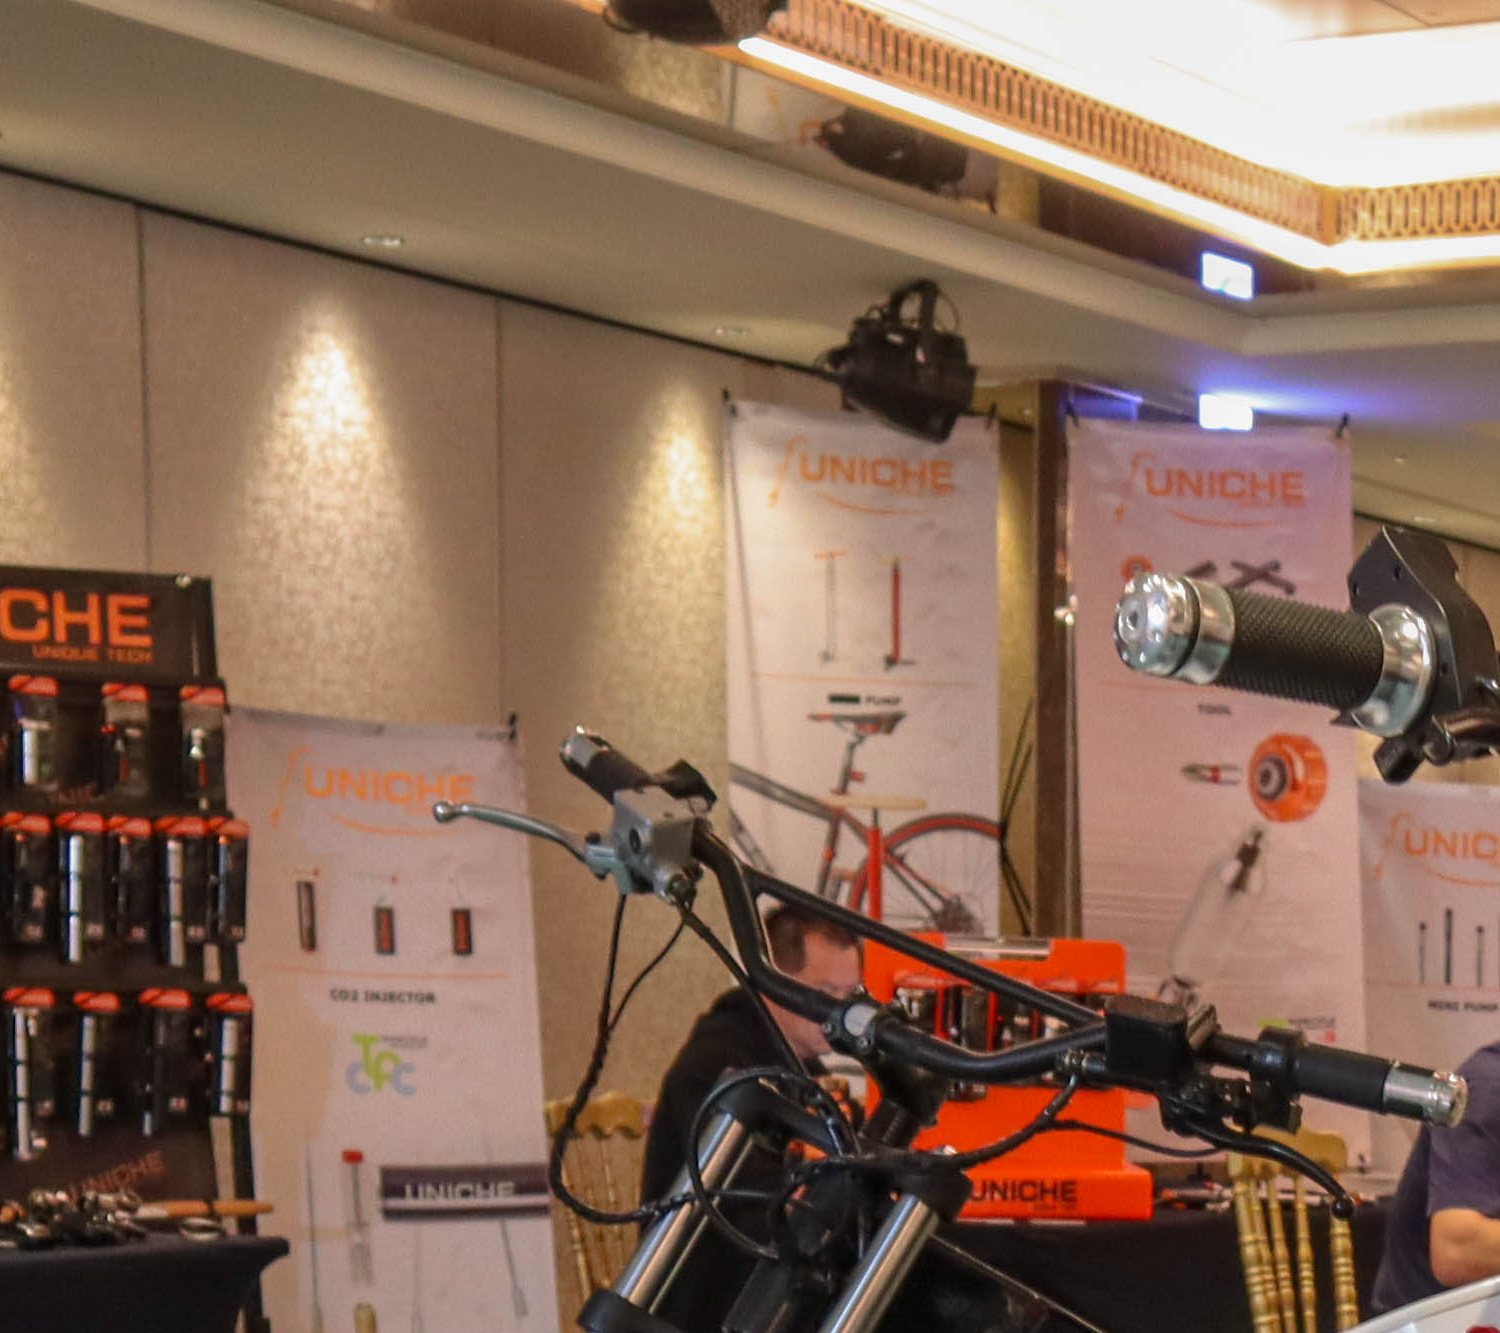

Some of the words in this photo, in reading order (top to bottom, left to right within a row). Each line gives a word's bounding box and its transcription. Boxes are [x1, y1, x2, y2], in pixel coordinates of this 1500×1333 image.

[801, 455, 955, 490] UNICHE
[1145, 467, 1306, 504] UNICHE
[304, 765, 476, 804] UNICHE
[364, 988, 437, 1005] INJECTOR
[404, 1181, 516, 1201] UNICHE
